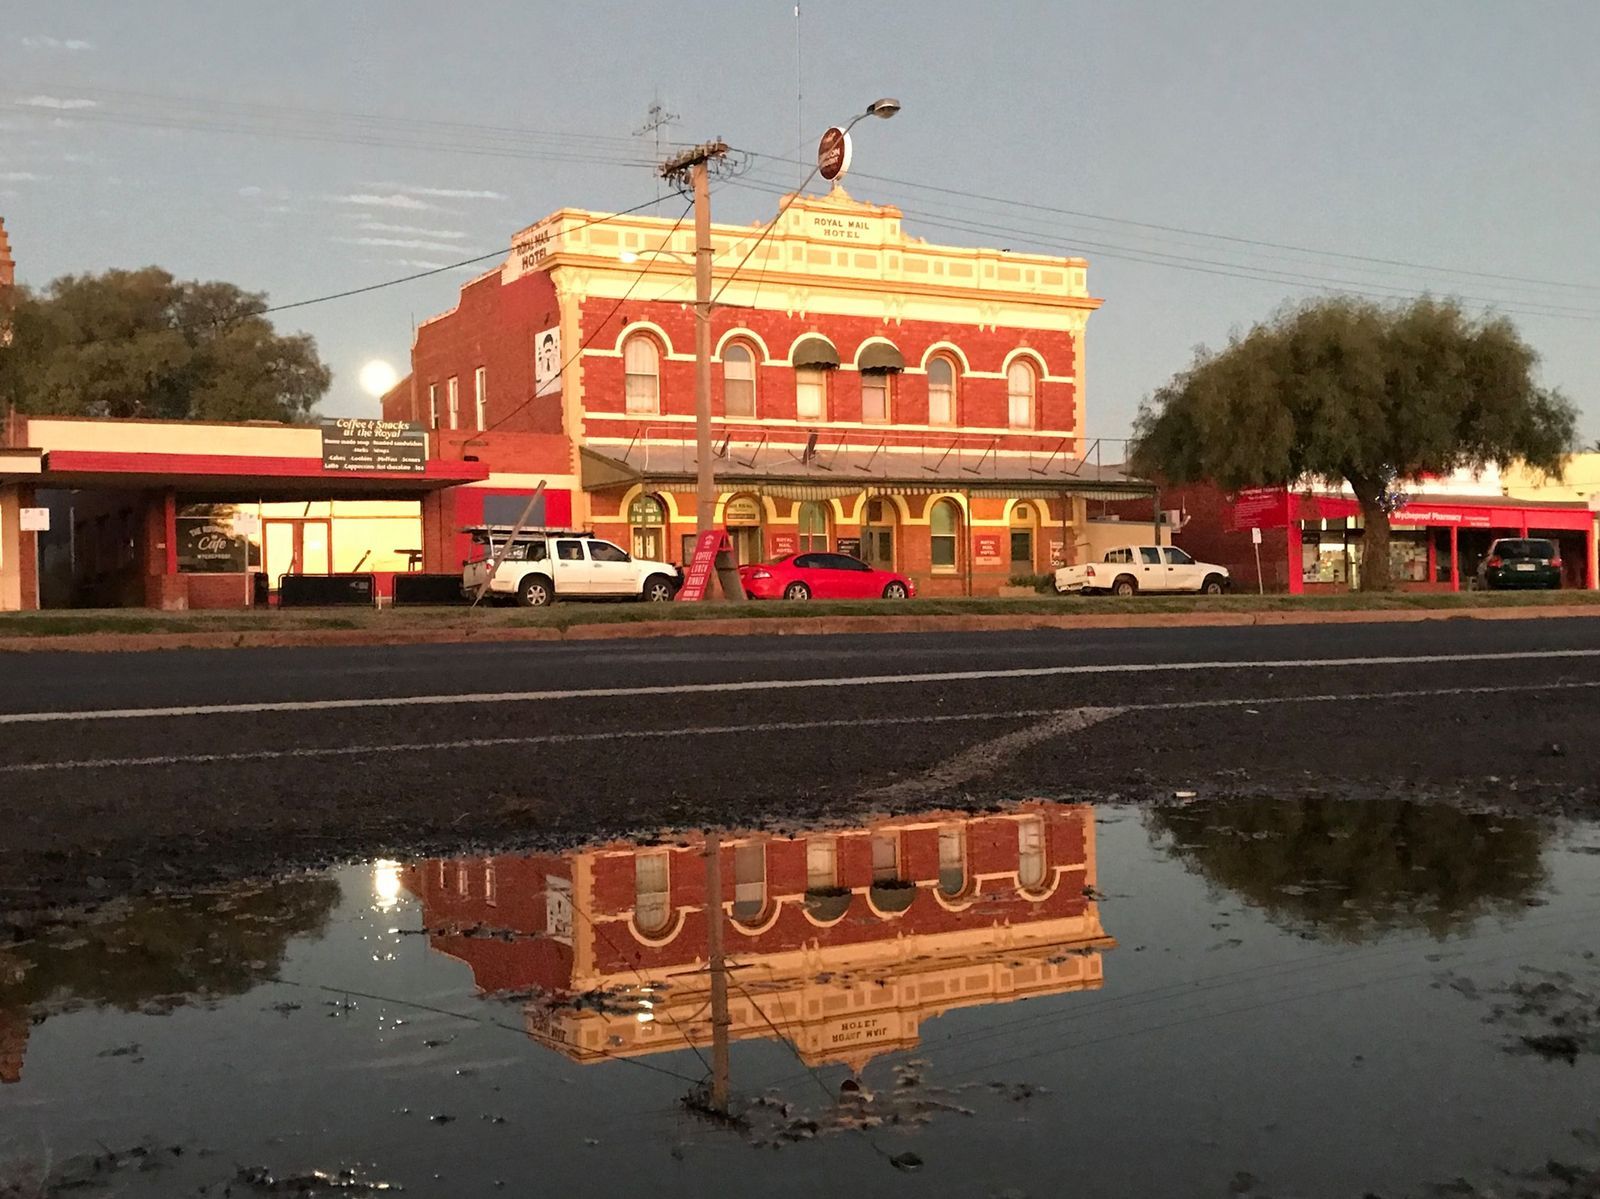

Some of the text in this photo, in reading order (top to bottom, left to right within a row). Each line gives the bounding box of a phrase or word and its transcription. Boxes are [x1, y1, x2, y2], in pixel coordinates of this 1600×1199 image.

[814, 218, 870, 230] ROYAL MAIL
[823, 229, 860, 239] HOTEL
[522, 247, 547, 270] HOTEL
[336, 419, 410, 430] Coffee & Snacks
[343, 429, 401, 440] at the Royal
[1431, 512, 1461, 522] Pharmacy
[198, 536, 227, 553] Cafe
[695, 551, 713, 561] COFFEE
